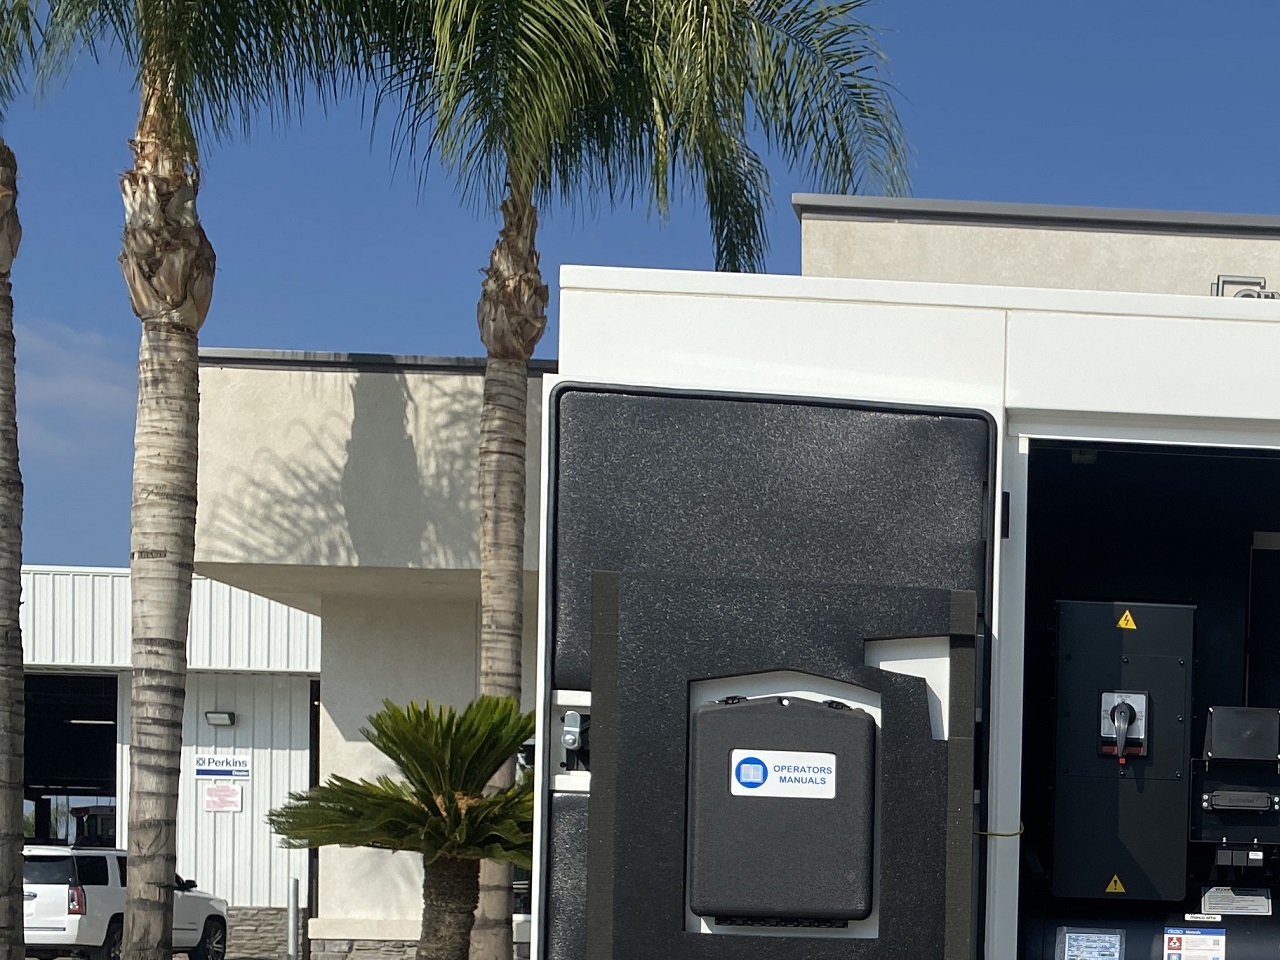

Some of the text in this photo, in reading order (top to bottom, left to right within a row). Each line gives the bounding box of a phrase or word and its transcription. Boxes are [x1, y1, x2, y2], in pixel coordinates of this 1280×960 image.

[207, 757, 247, 767] Perkins
[773, 765, 832, 775] OPERATORS
[779, 776, 826, 785] MANUALS
